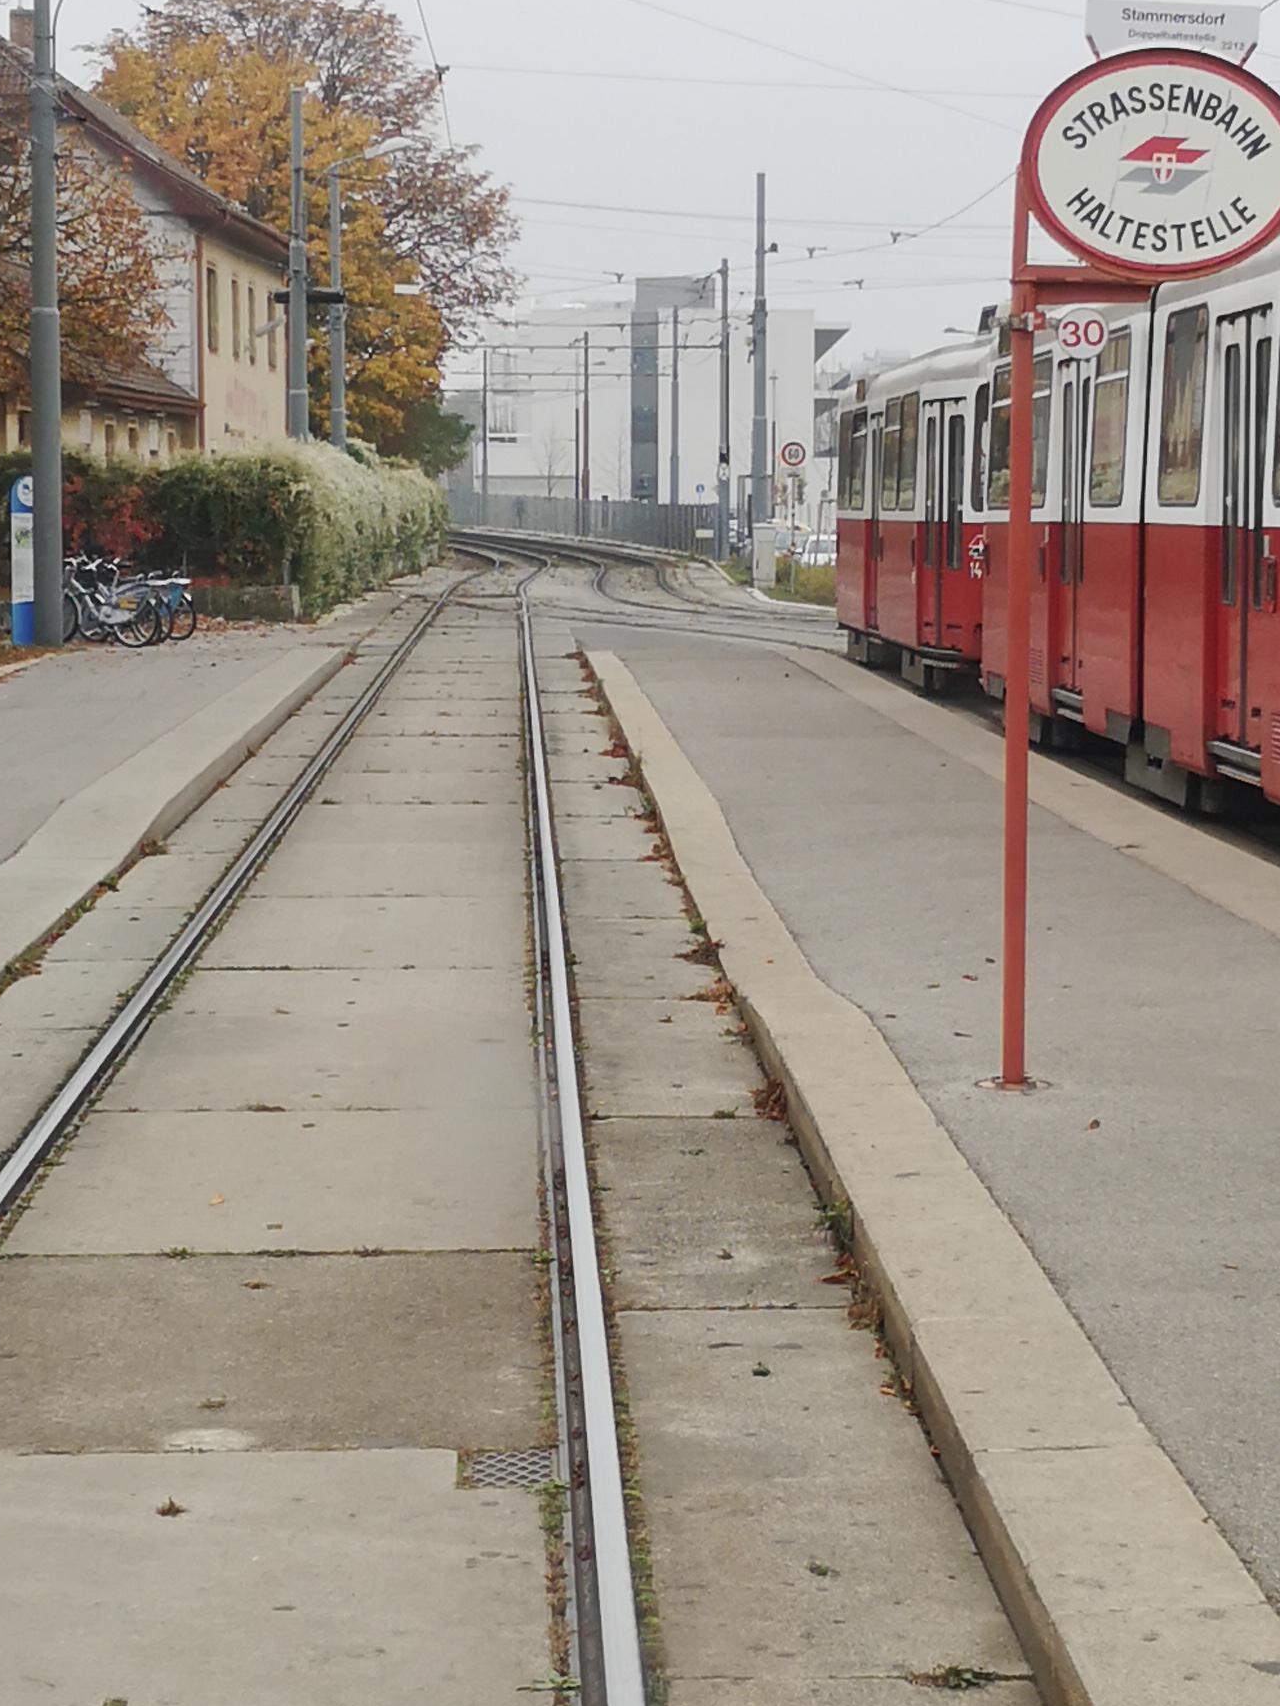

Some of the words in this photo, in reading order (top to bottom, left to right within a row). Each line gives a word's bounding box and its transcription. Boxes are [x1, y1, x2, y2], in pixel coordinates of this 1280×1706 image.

[1121, 7, 1226, 26] Stammersdorf
[1061, 82, 1273, 161] STRASSENBAHN
[1065, 186, 1257, 253] HALTESTELLE
[1062, 319, 1104, 347] 30
[787, 447, 800, 460] 60
